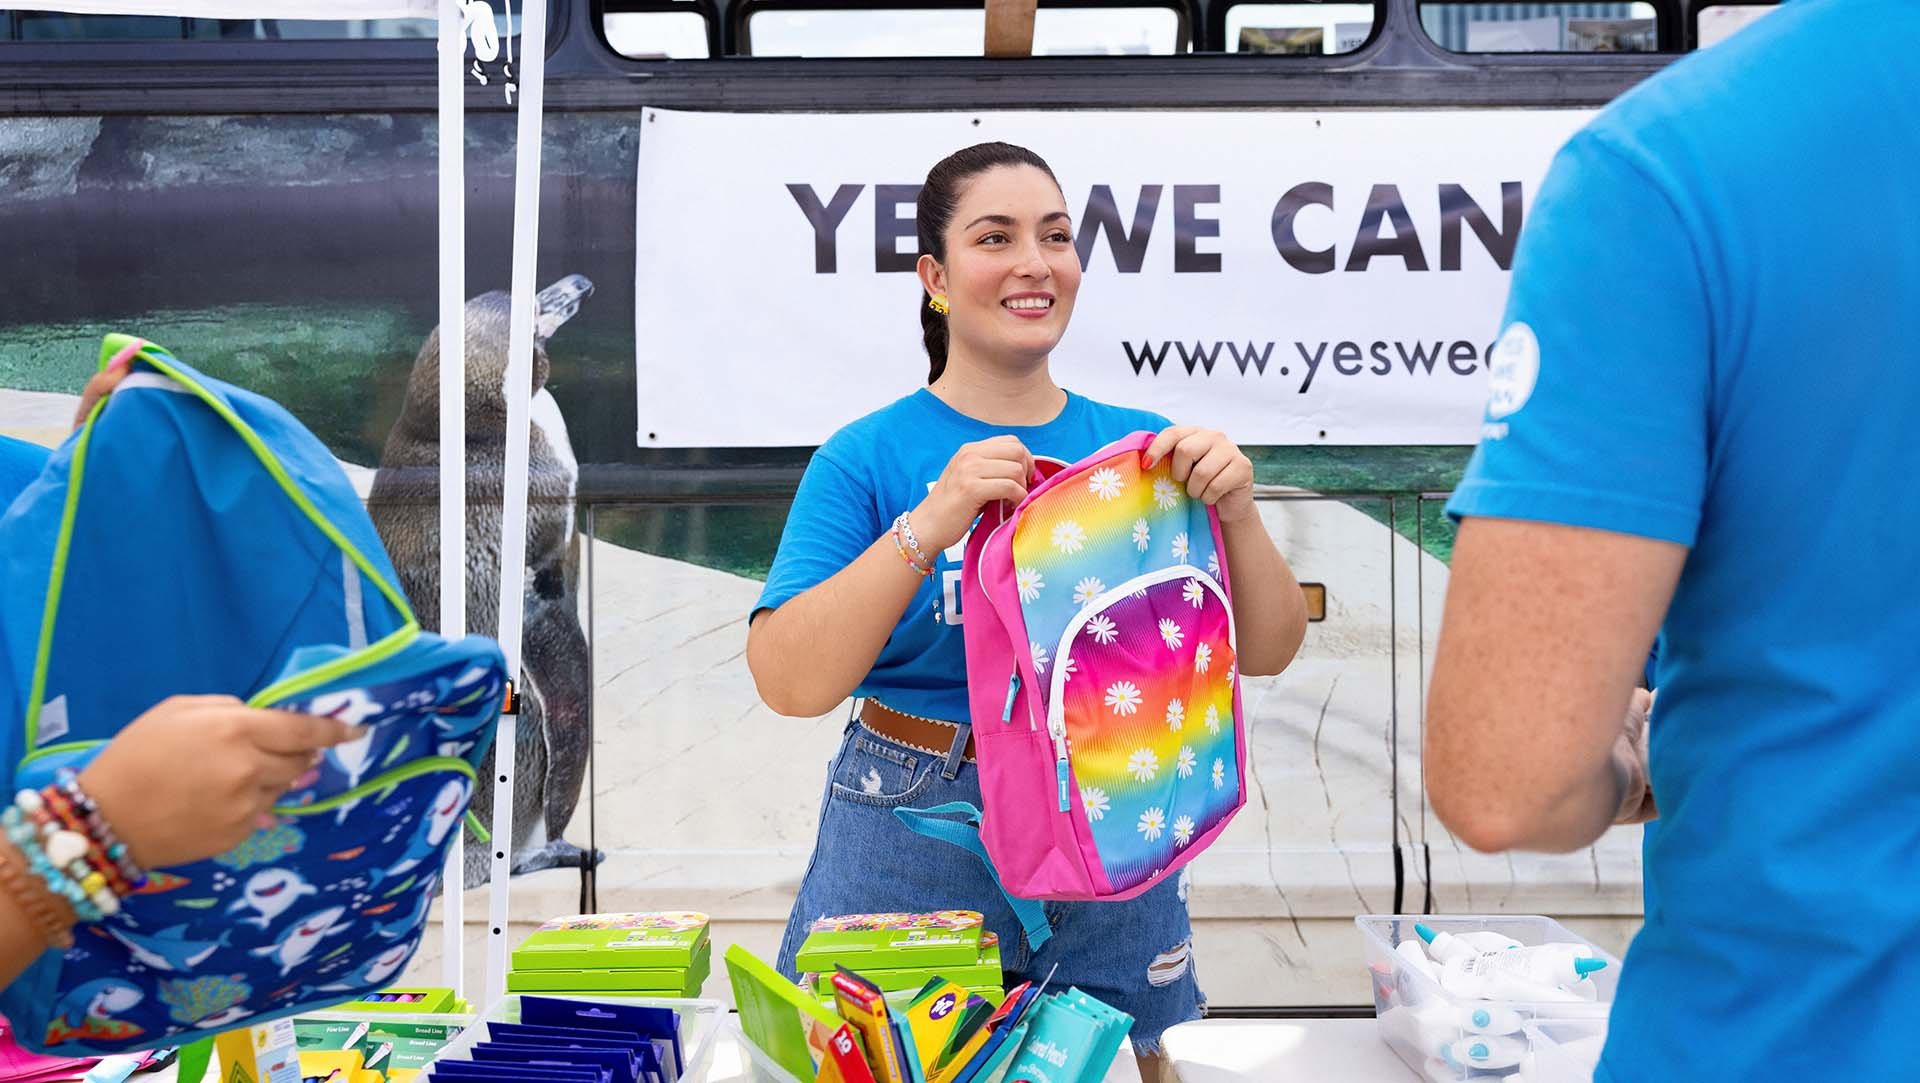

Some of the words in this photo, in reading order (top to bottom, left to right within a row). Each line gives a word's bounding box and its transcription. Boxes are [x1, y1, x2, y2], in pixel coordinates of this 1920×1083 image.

[785, 183, 918, 274] YE
[1081, 183, 1222, 274] WE
[1271, 181, 1523, 274] CAN
